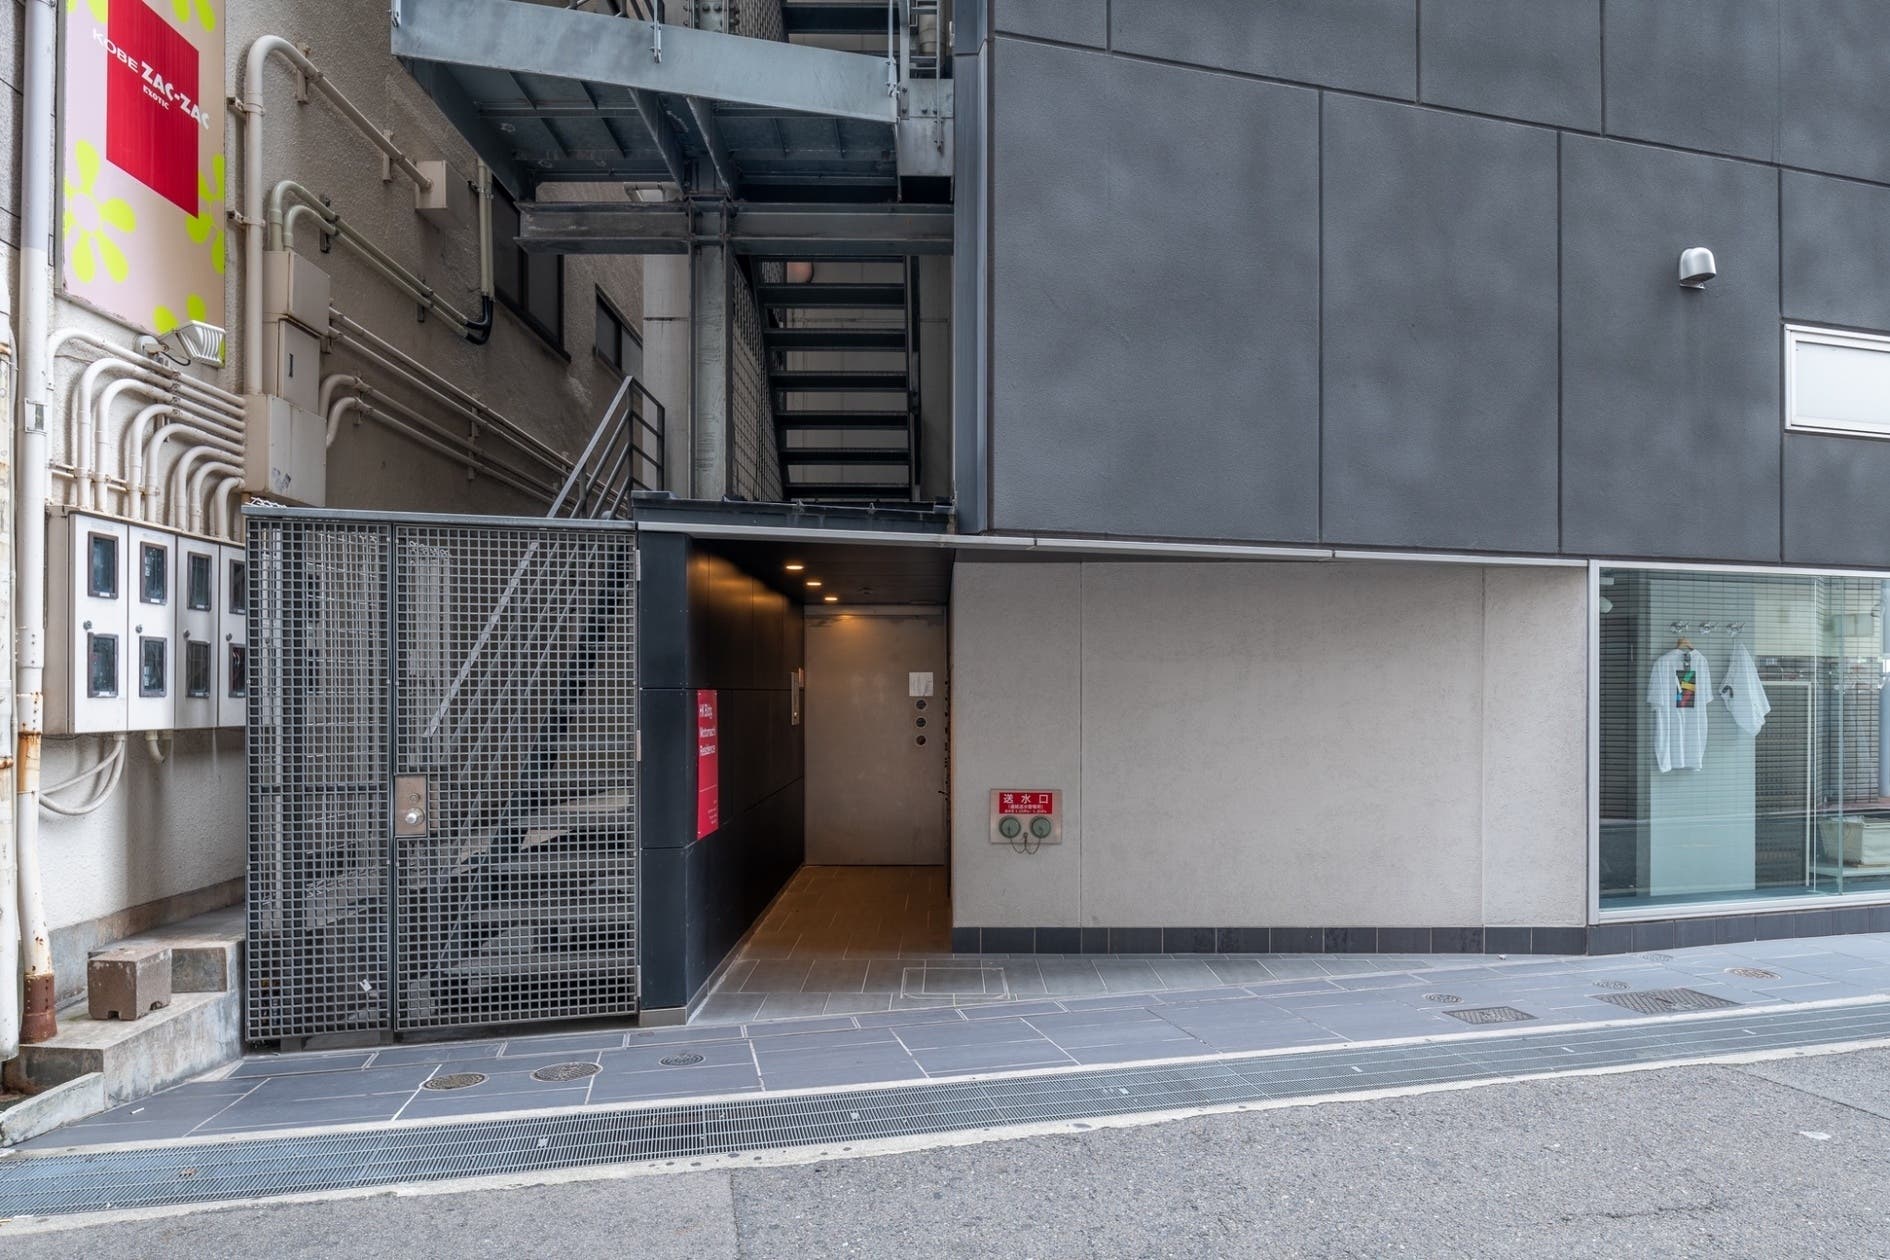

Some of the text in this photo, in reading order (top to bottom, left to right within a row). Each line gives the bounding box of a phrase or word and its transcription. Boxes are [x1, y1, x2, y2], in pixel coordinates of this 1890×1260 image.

[92, 28, 209, 130] KOBE ZAC-ZAC
[143, 84, 170, 110] EXOTIC
[1003, 793, 1049, 804] 送水口
